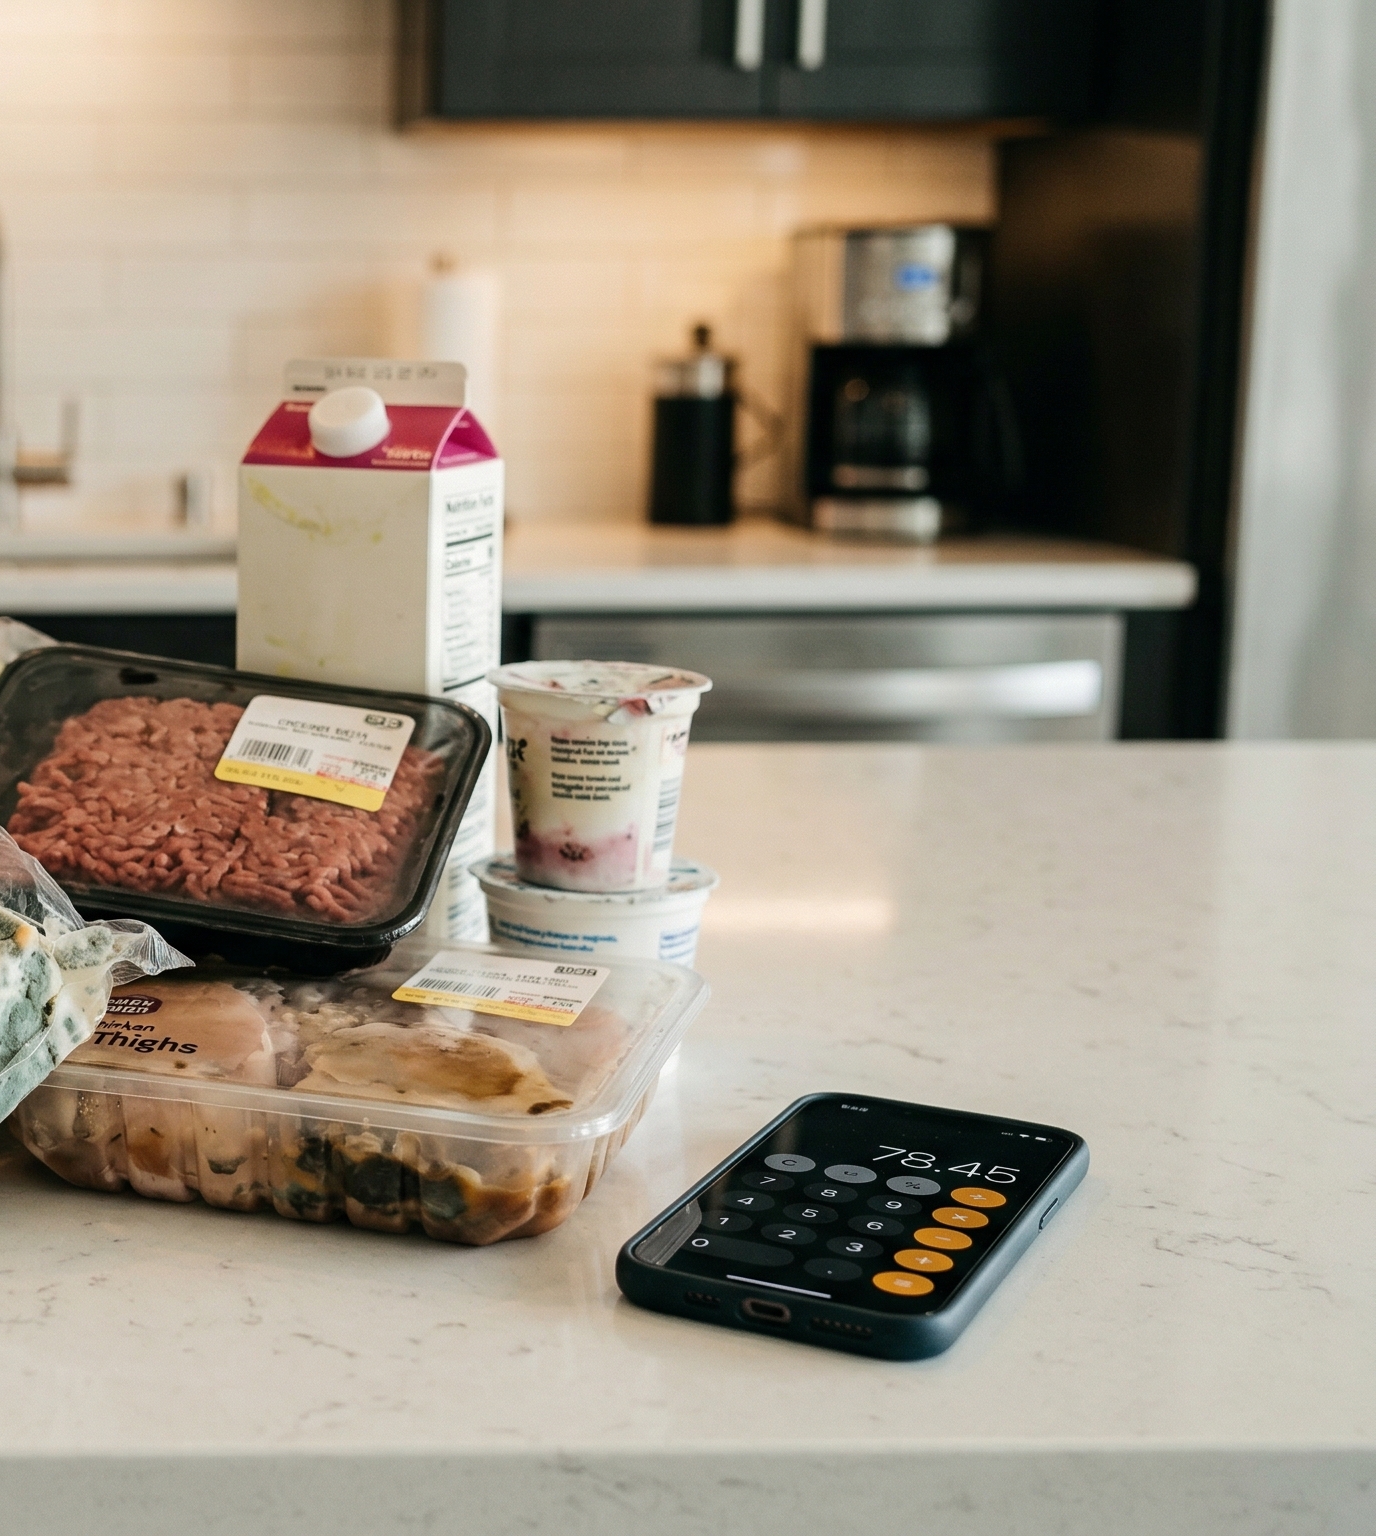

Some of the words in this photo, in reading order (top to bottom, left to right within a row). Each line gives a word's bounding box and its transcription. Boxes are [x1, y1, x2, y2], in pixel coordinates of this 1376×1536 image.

[93, 1031, 199, 1054] Thighs
[872, 1145, 1021, 1184] 78.45
[760, 1176, 776, 1185] 7
[737, 1197, 755, 1205] 4
[885, 1201, 902, 1210] 9
[802, 1208, 819, 1218] 5
[866, 1221, 884, 1231] 6
[778, 1229, 797, 1240] 2
[691, 1238, 710, 1248] 0
[845, 1242, 864, 1252] 3
